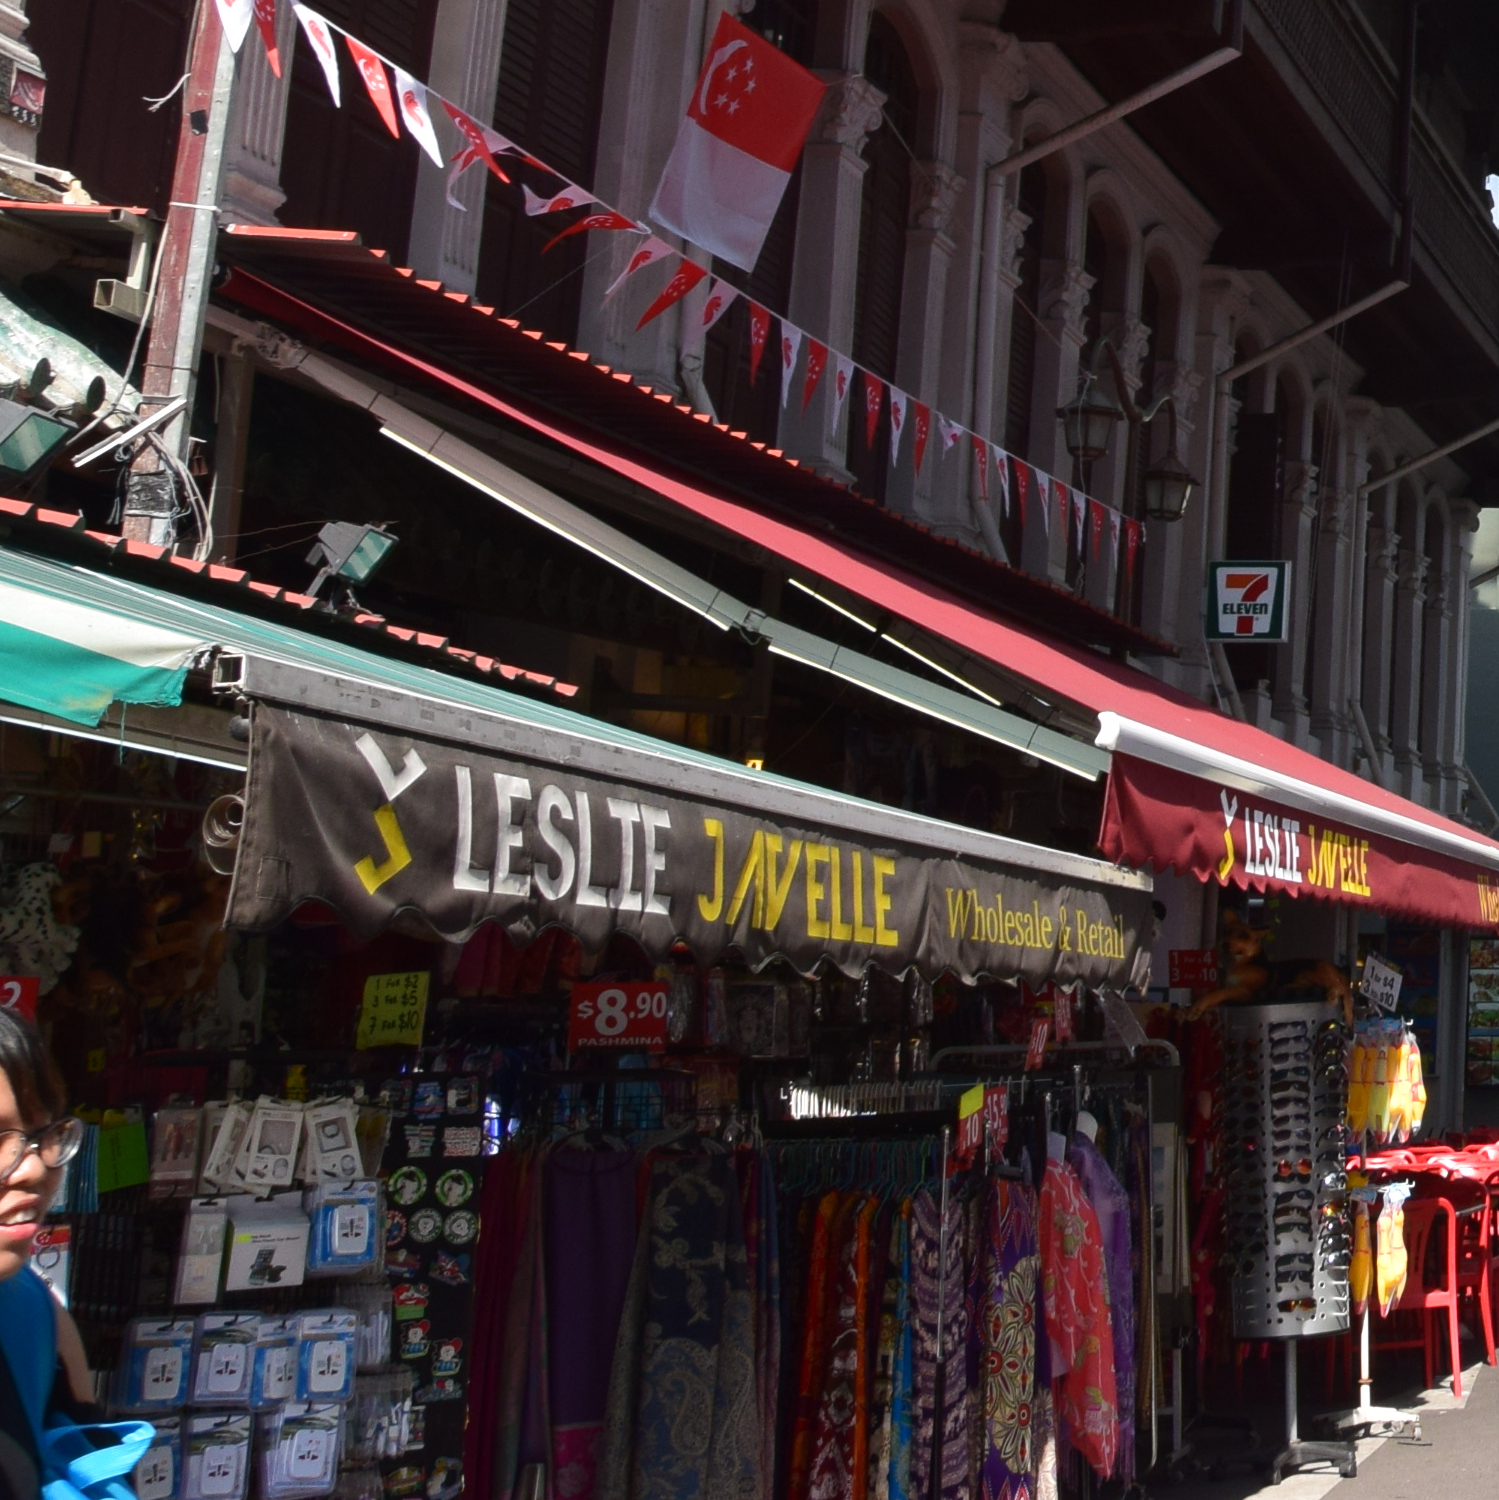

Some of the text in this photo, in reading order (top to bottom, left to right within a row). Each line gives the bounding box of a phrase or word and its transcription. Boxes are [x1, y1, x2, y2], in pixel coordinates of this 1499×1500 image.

[1225, 573, 1269, 635] 7
[453, 765, 899, 948] LESLIE JAVELLE
[1244, 806, 1371, 897] LESLIE JAVELLE
[945, 886, 1126, 960] Wholesale & Retail
[404, 974, 420, 990] $2
[1363, 979, 1371, 994] 3
[1379, 991, 1395, 1008] $10
[1382, 976, 1395, 991] $4
[372, 995, 380, 1008] 3
[401, 990, 418, 1007] $5
[577, 988, 667, 1037] $8.90
[398, 1010, 420, 1033] $10
[577, 1035, 664, 1046] PASHMINA
